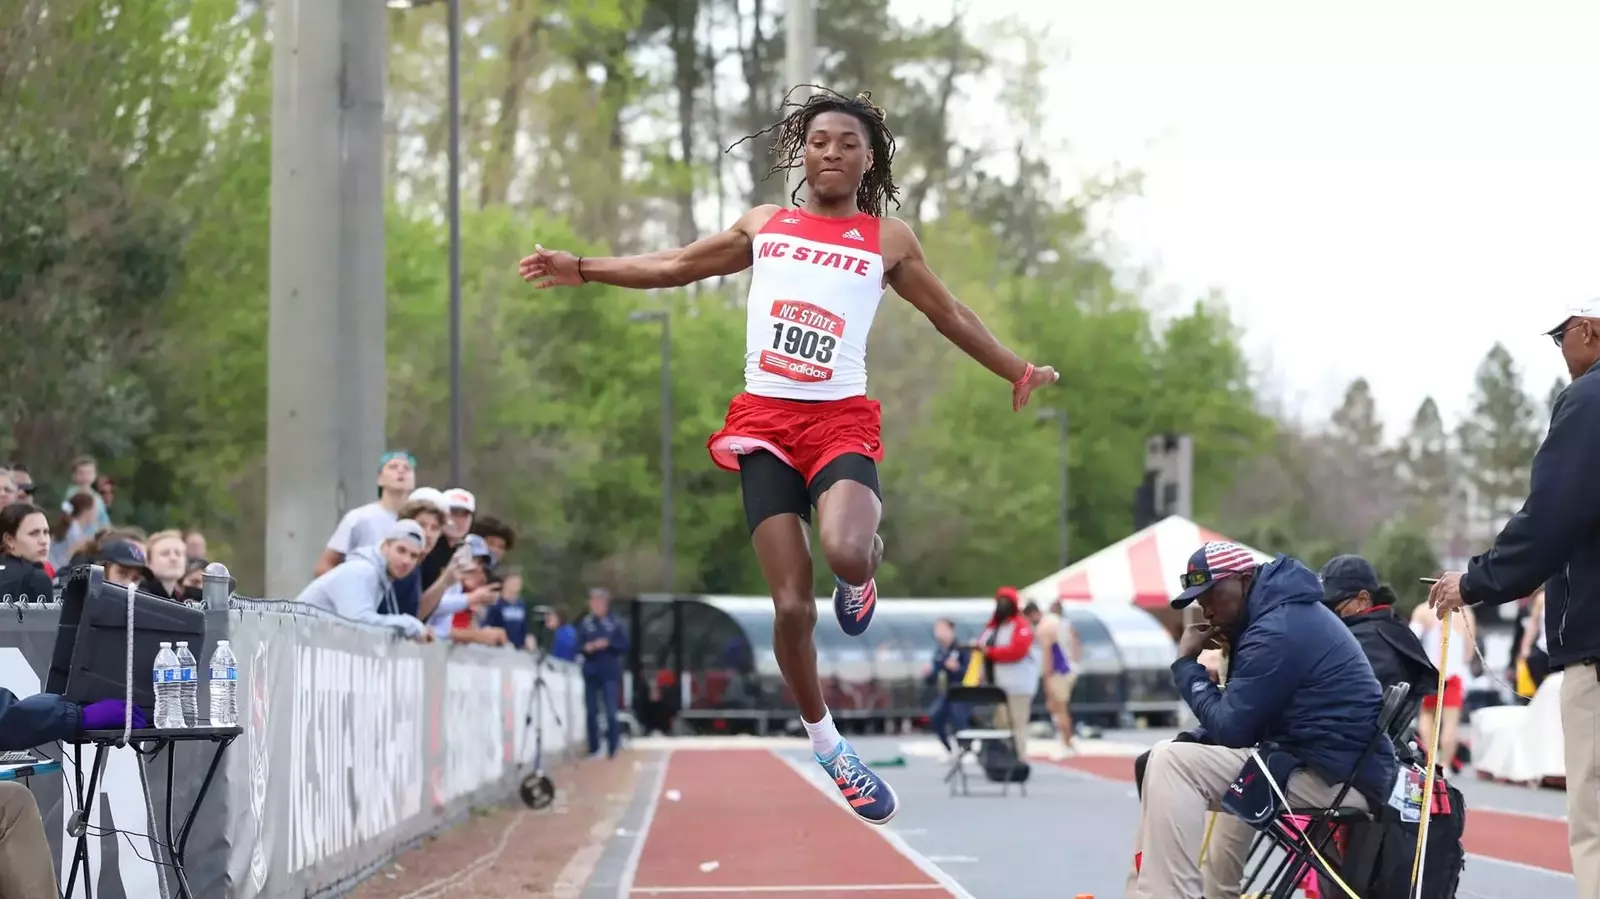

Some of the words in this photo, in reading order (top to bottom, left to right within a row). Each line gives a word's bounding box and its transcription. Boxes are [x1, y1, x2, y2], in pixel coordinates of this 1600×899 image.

[758, 242, 790, 259] NC
[792, 247, 871, 277] STATE
[779, 304, 799, 320] NC
[799, 309, 837, 332] STATE
[772, 322, 837, 364] 1903
[788, 363, 827, 379] adidas
[1230, 782, 1244, 794] USA
